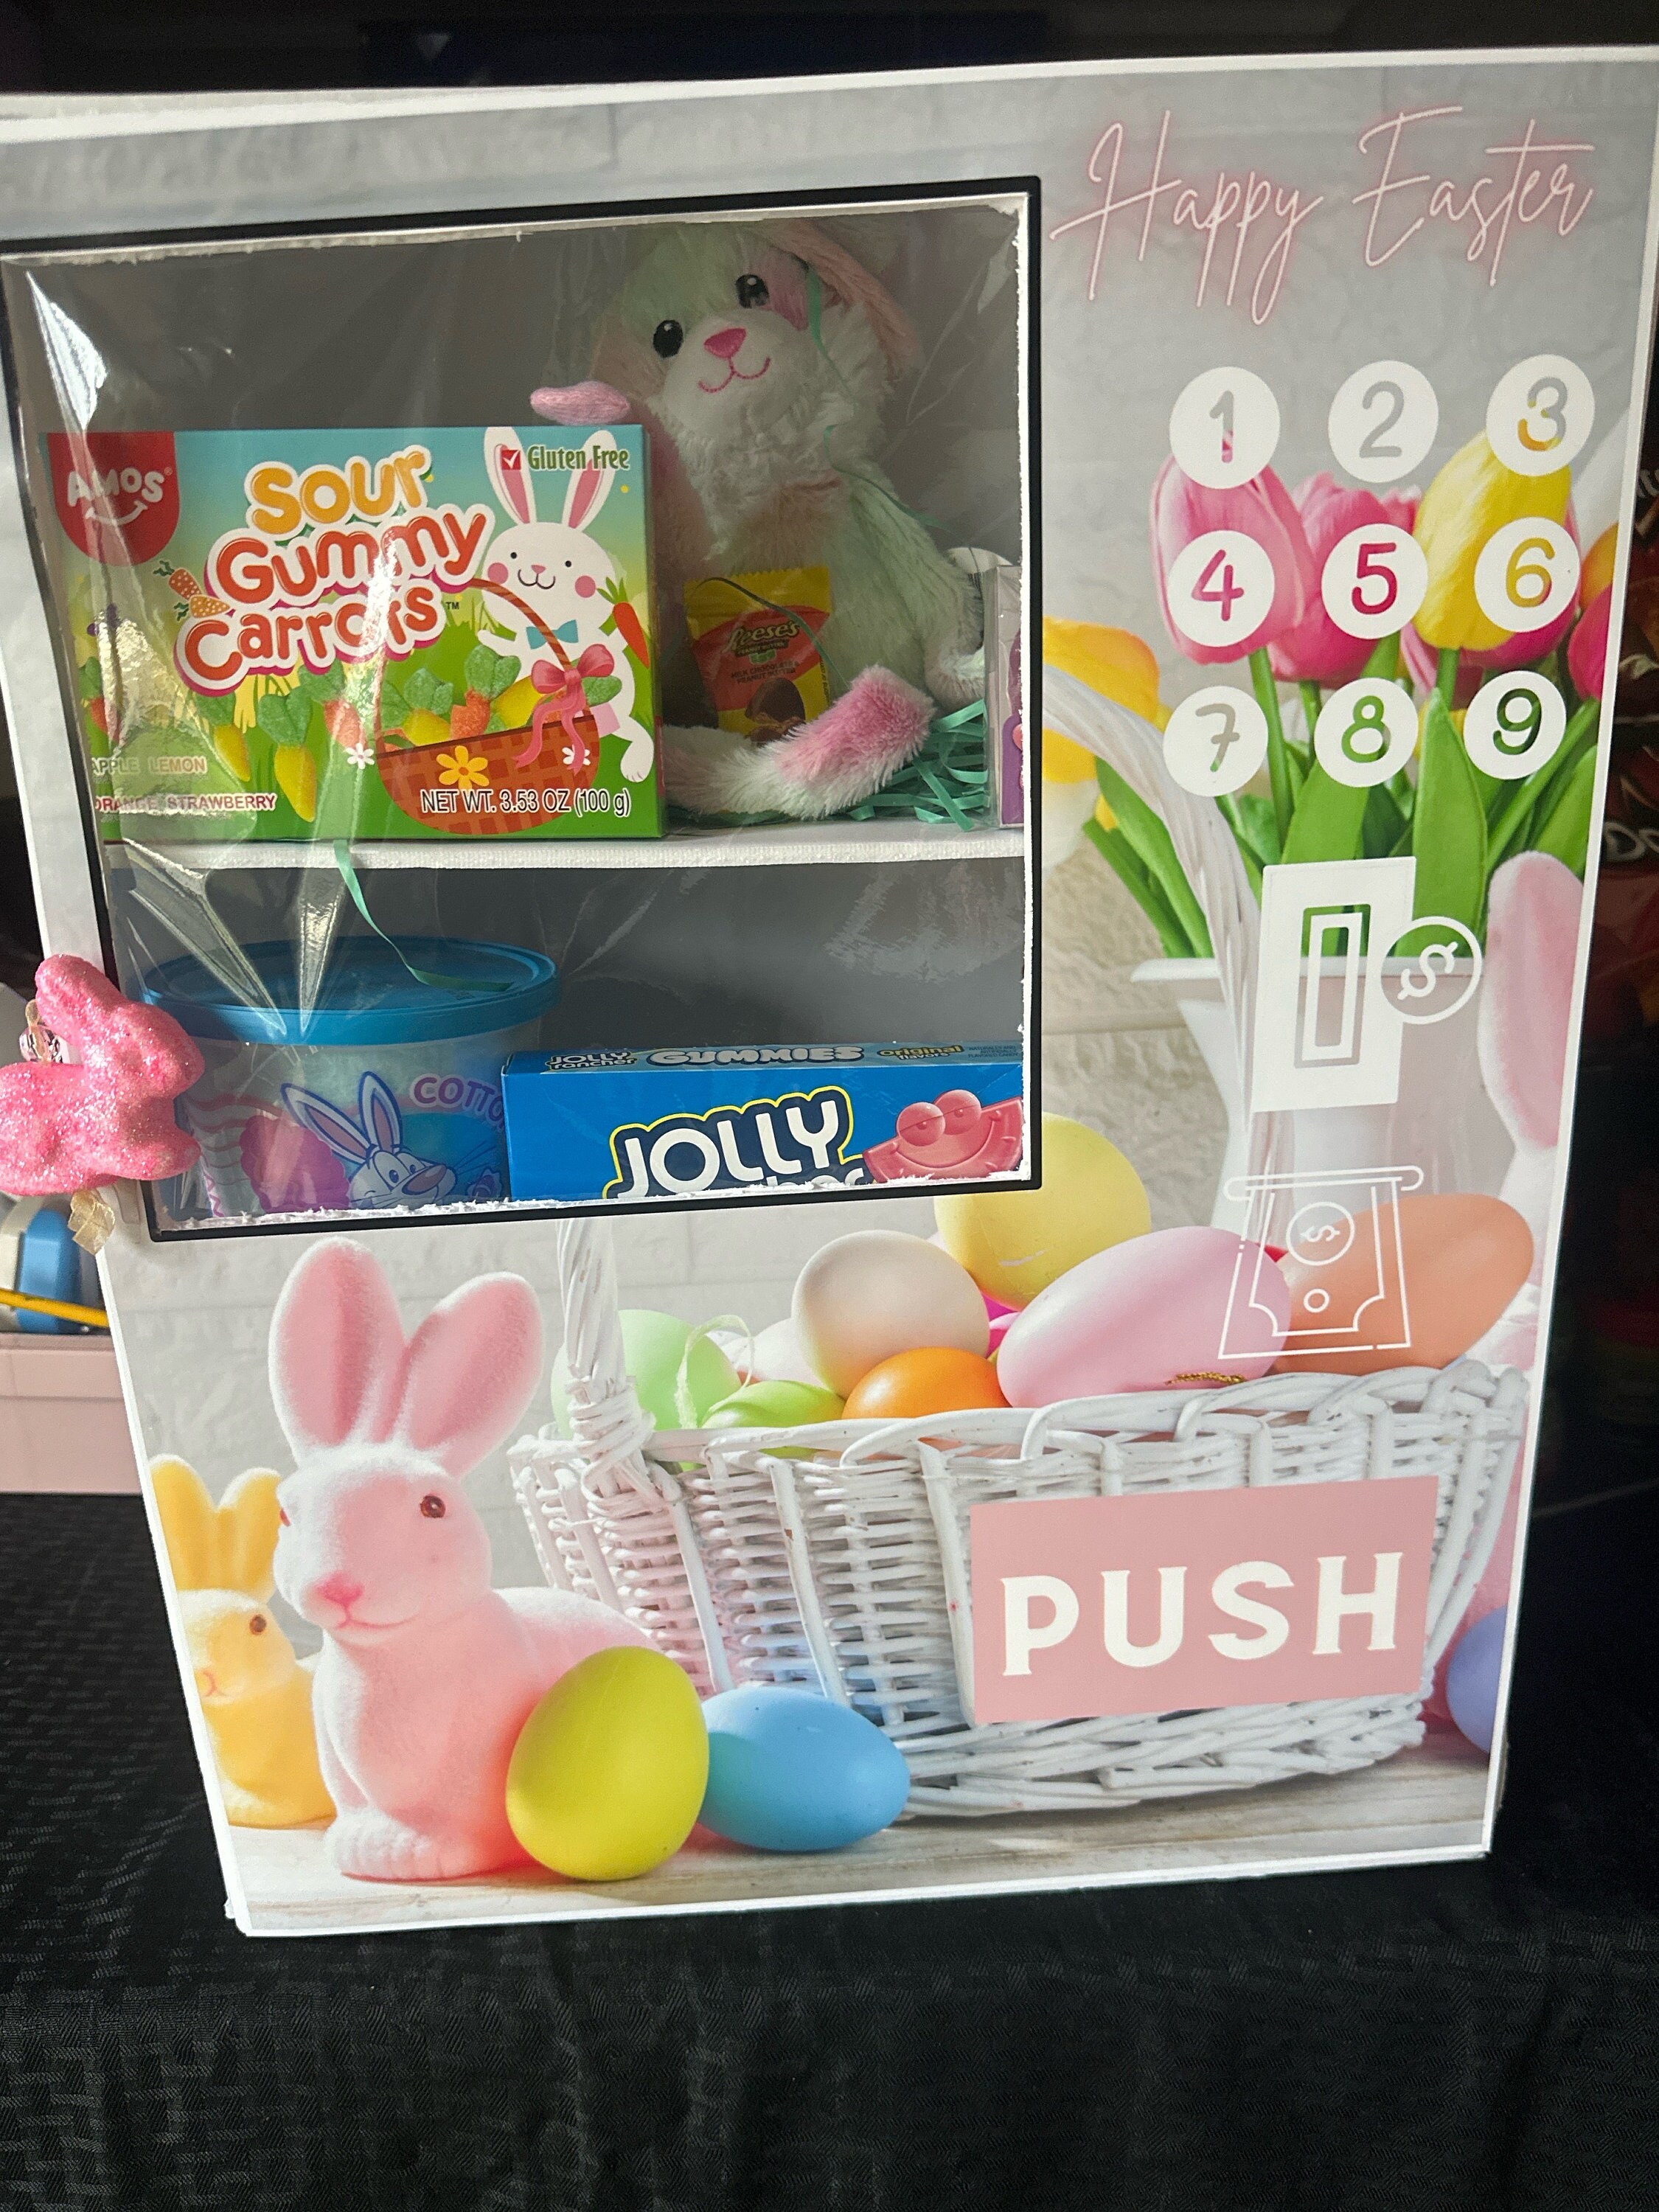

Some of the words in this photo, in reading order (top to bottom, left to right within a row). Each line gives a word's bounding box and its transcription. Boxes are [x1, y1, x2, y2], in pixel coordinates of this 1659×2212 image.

[1049, 111, 1324, 324] Happy
[1353, 106, 1595, 286] Easter
[1360, 380, 1405, 458] 2
[1517, 377, 1568, 451] 3
[526, 445, 587, 470] Gluten
[592, 445, 630, 470] Free
[250, 451, 425, 535] Sour
[216, 512, 487, 604] Gummy
[1191, 549, 1245, 622] 4
[1351, 542, 1398, 615] 5
[1505, 537, 1556, 608] 6
[1194, 702, 1240, 773] 7
[1340, 695, 1391, 764] 8
[1492, 687, 1543, 756] 9
[149, 756, 207, 774] LEMON
[166, 793, 277, 811] STRAWBERRY
[421, 790, 458, 813] NET
[463, 790, 496, 812] WT.
[500, 790, 538, 813] 3.53
[542, 790, 571, 812] OZ
[574, 788, 608, 817] (100
[613, 788, 631, 817] g)
[552, 1051, 630, 1064] JOLLY
[647, 1045, 863, 1065] GUMMIES
[879, 1045, 963, 1057] original
[898, 1052, 951, 1060] flavors
[414, 1077, 504, 1129] COTTO
[616, 1100, 840, 1198] JOLLY
[999, 1551, 1405, 1677] PUSH
